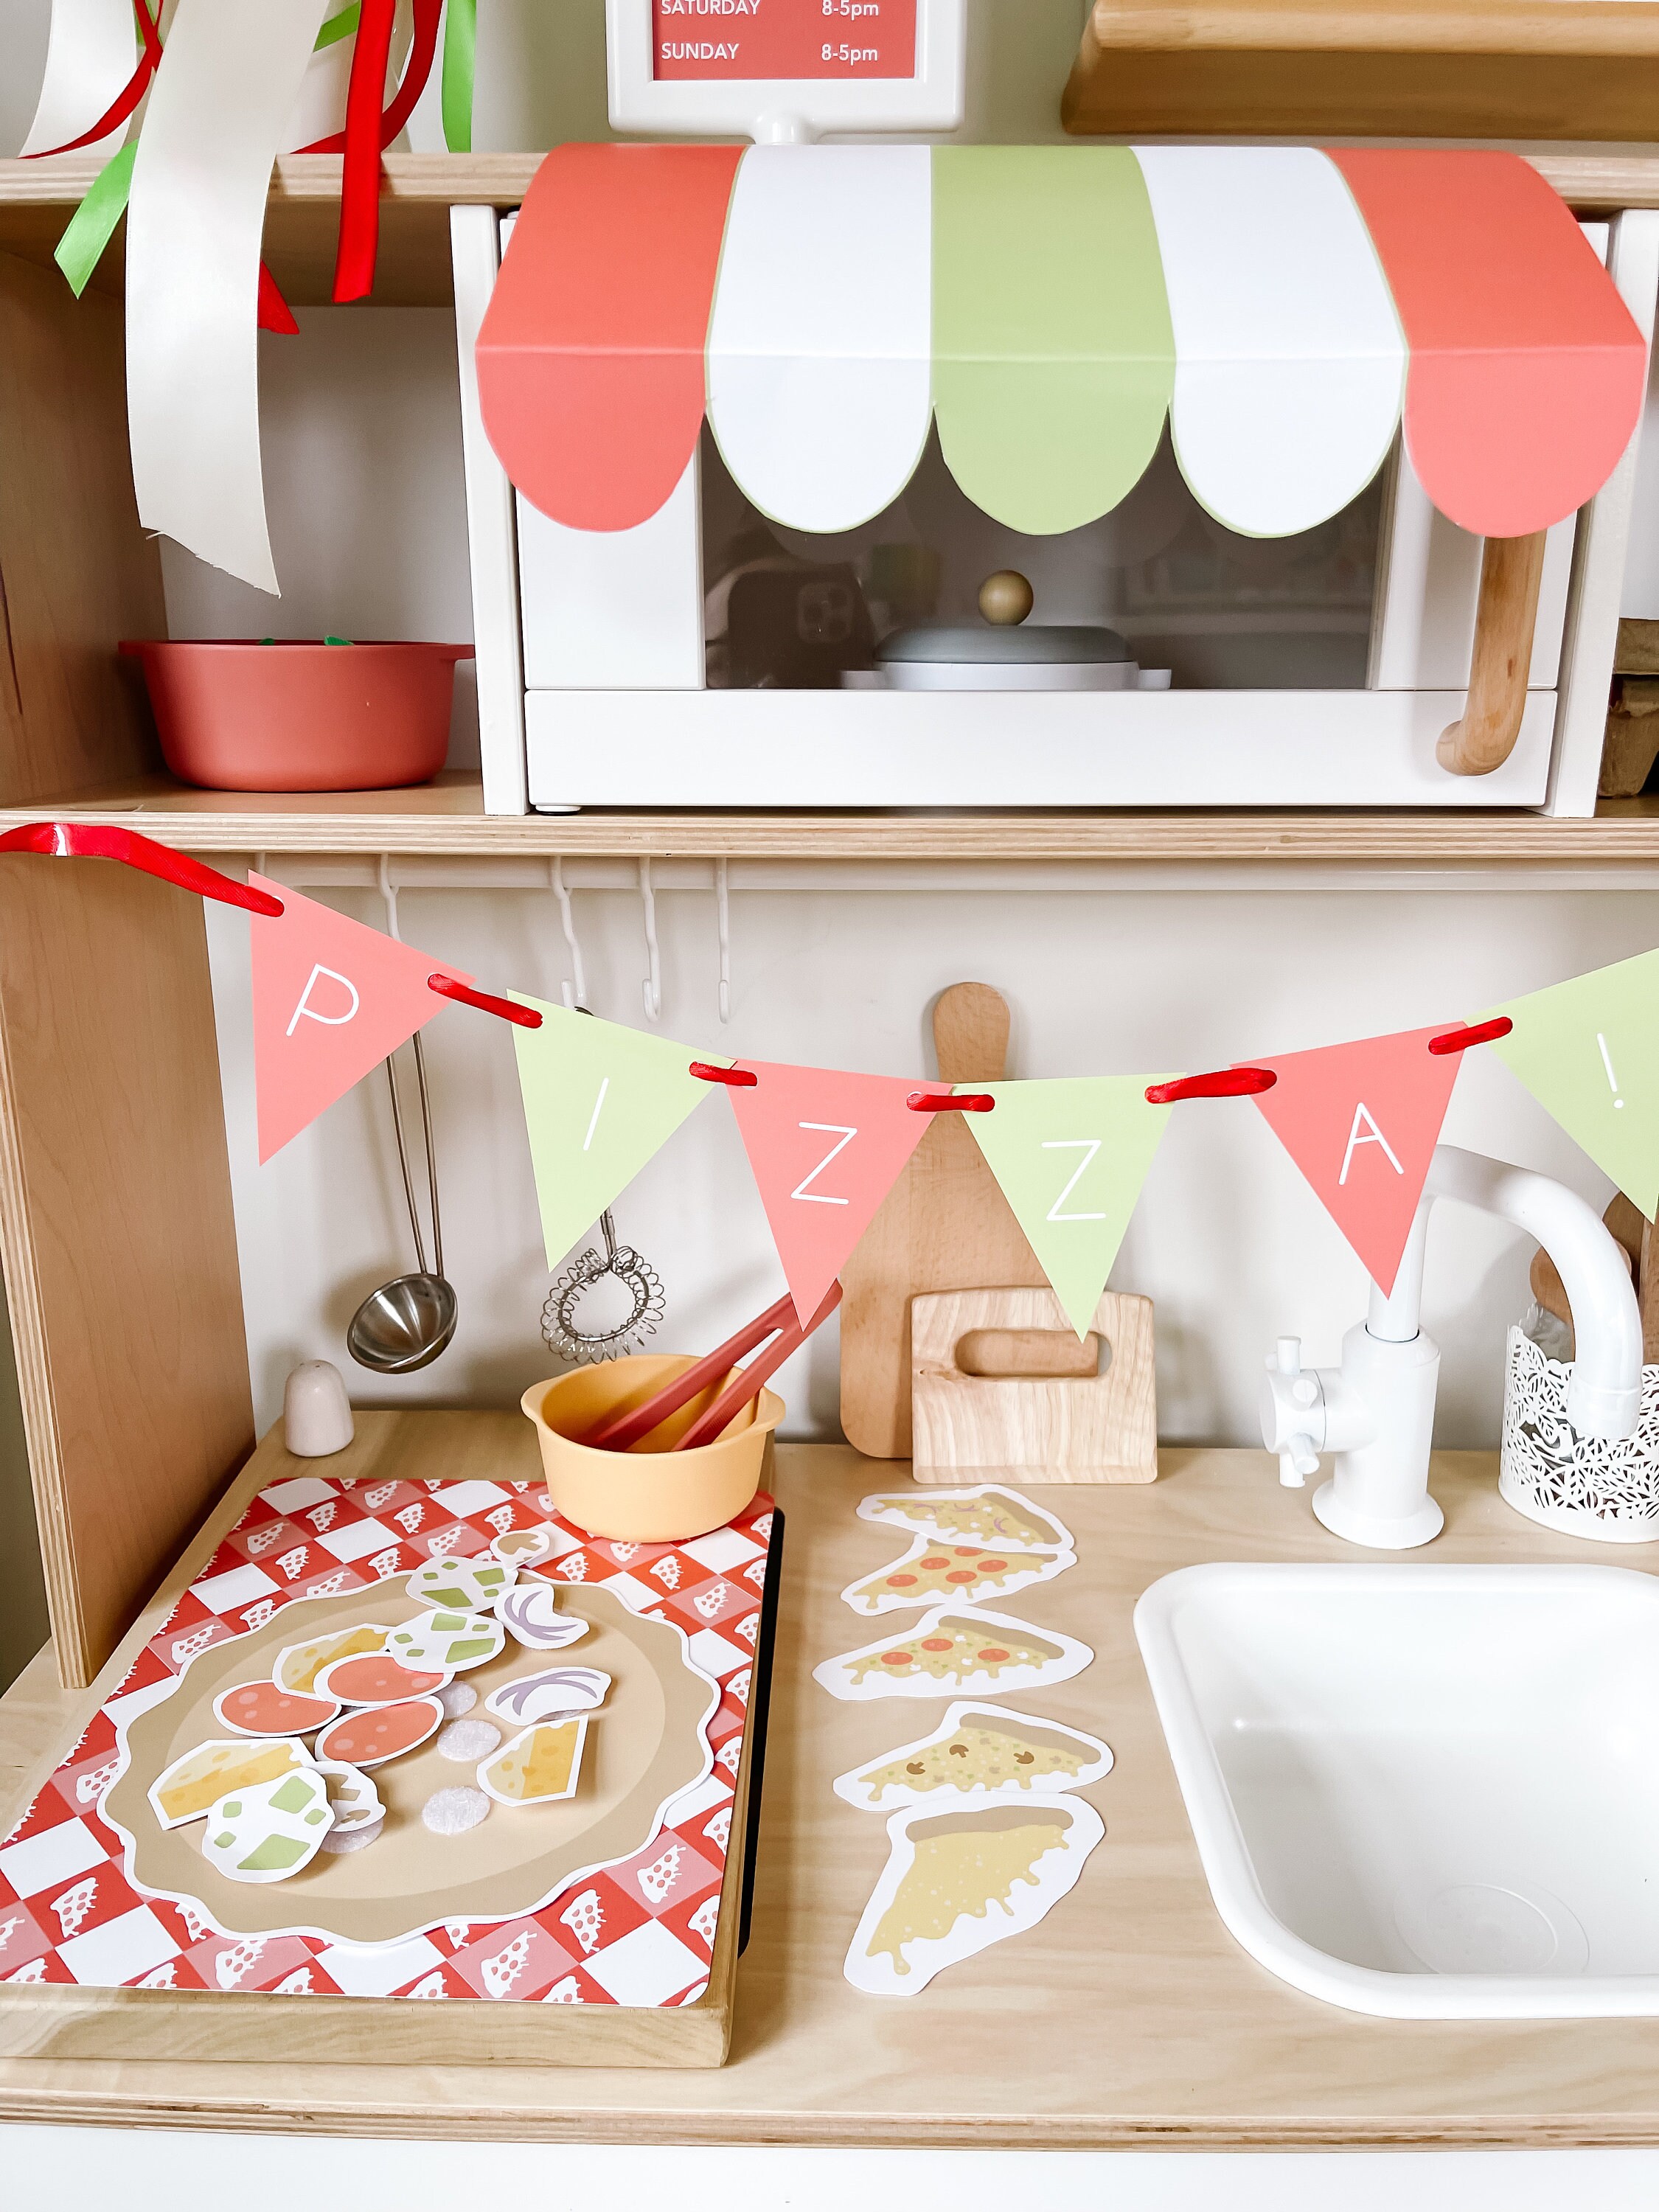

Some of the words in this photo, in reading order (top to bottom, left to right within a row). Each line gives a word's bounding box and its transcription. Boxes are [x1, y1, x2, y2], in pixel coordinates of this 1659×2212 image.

[661, 0, 760, 15] SATURDAY
[821, 0, 880, 21] 8-5pm
[661, 42, 740, 60] SUNDAY
[821, 44, 879, 66] 8-5pm
